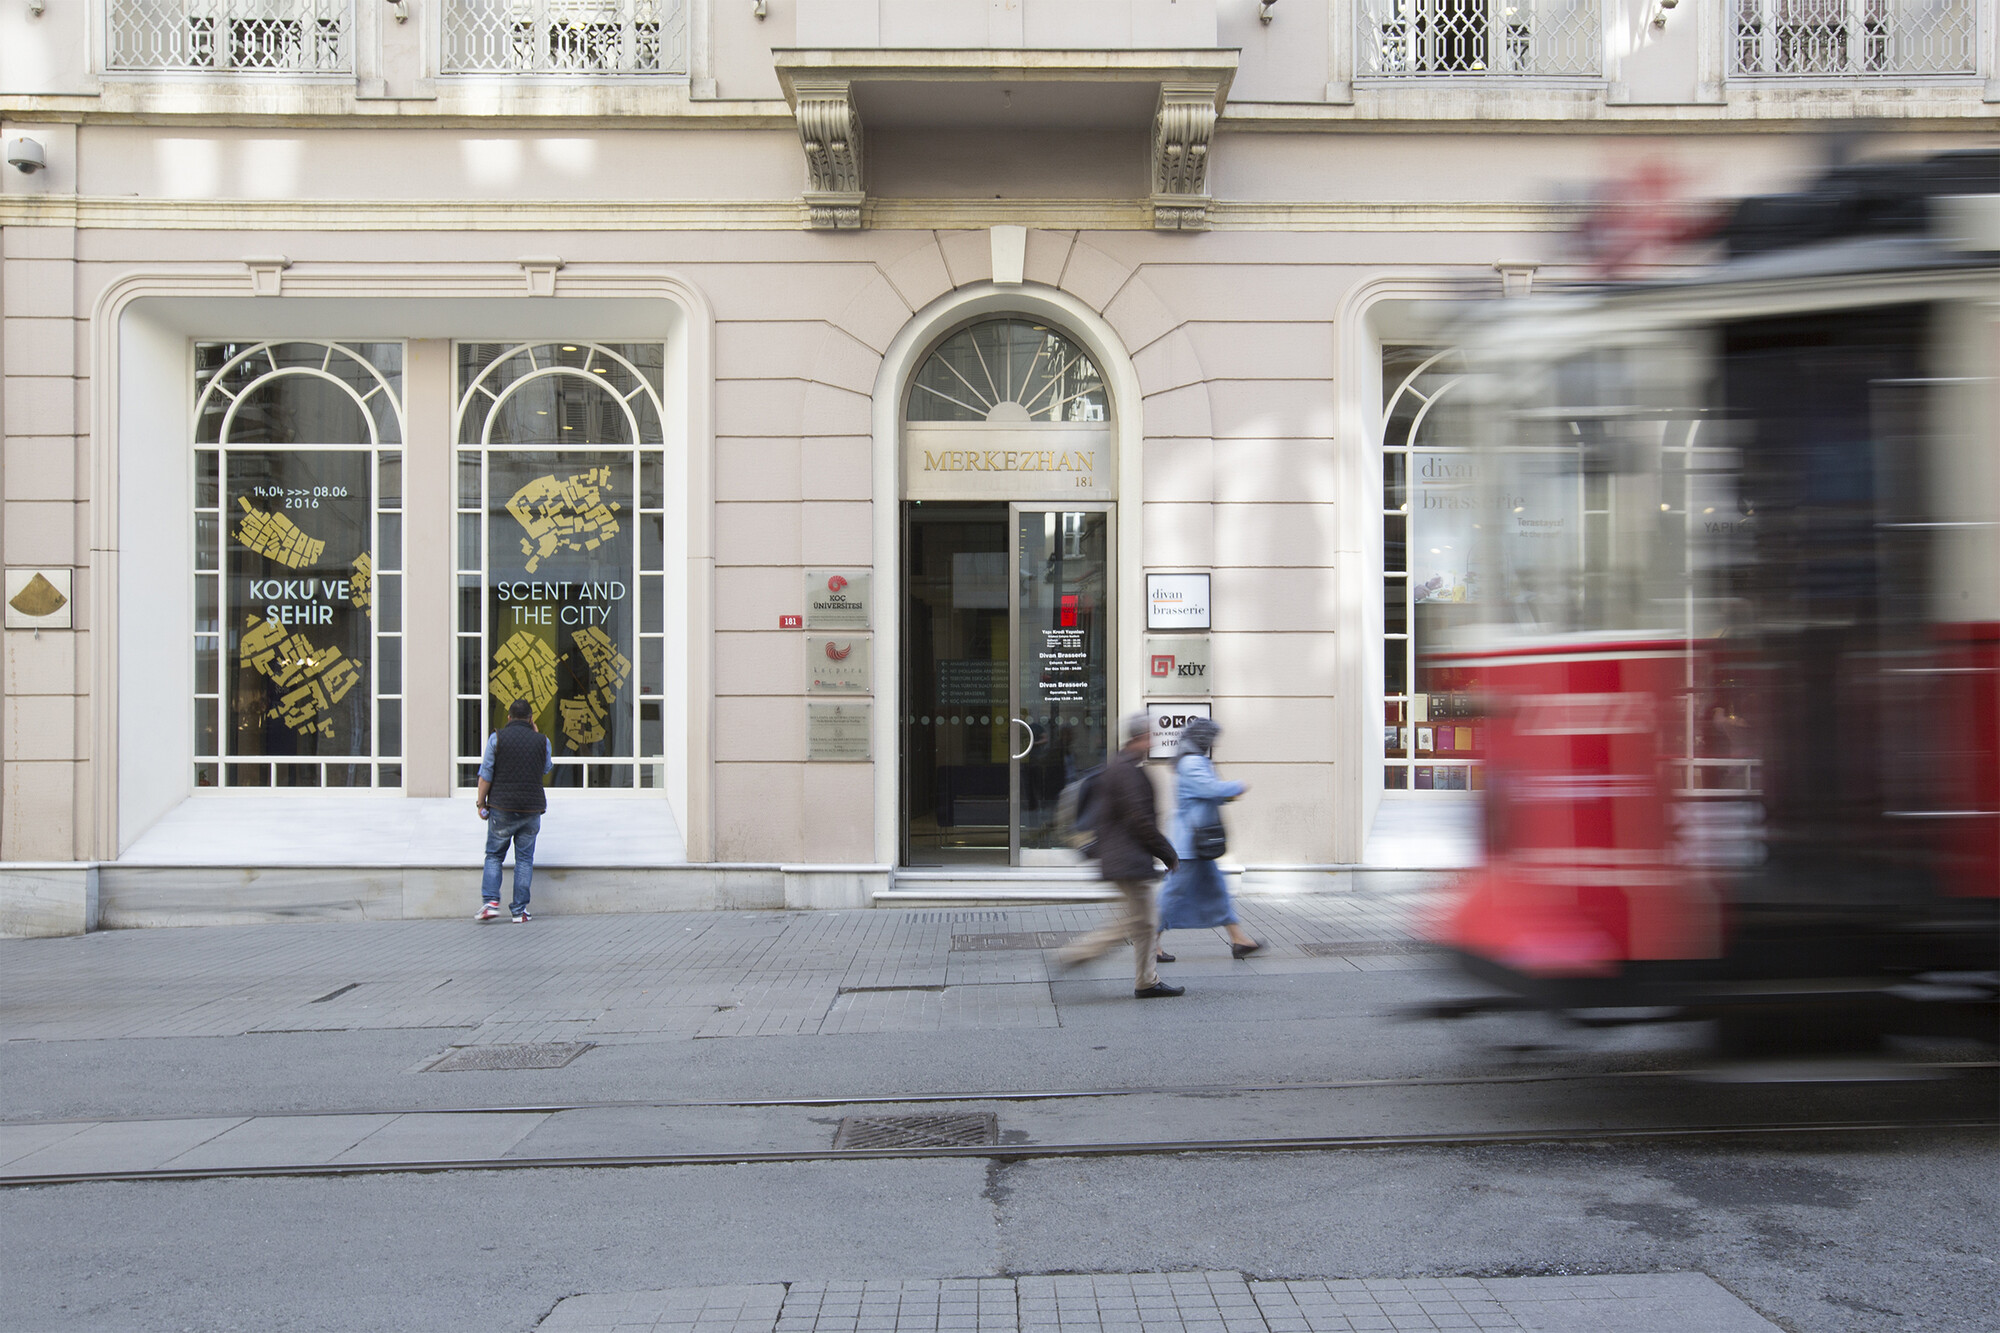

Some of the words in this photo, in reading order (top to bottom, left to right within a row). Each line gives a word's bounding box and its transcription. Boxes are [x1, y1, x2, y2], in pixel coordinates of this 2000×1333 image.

[924, 450, 1095, 472] MERKEZHAN
[1075, 476, 1093, 487] 181
[253, 486, 284, 497] 14.04
[313, 486, 347, 497] 08.06
[285, 498, 319, 508] 2016
[250, 580, 314, 600] KOKU
[321, 580, 350, 600] VE
[498, 581, 572, 600] SCENT
[579, 581, 626, 600] AND
[1152, 588, 1183, 599] divan
[266, 599, 334, 629] ŞEHİR
[511, 605, 552, 625] THE
[560, 605, 612, 625] CITY
[1153, 603, 1205, 615] brasserie
[784, 617, 797, 625] 181
[1178, 662, 1206, 676] KÜY
